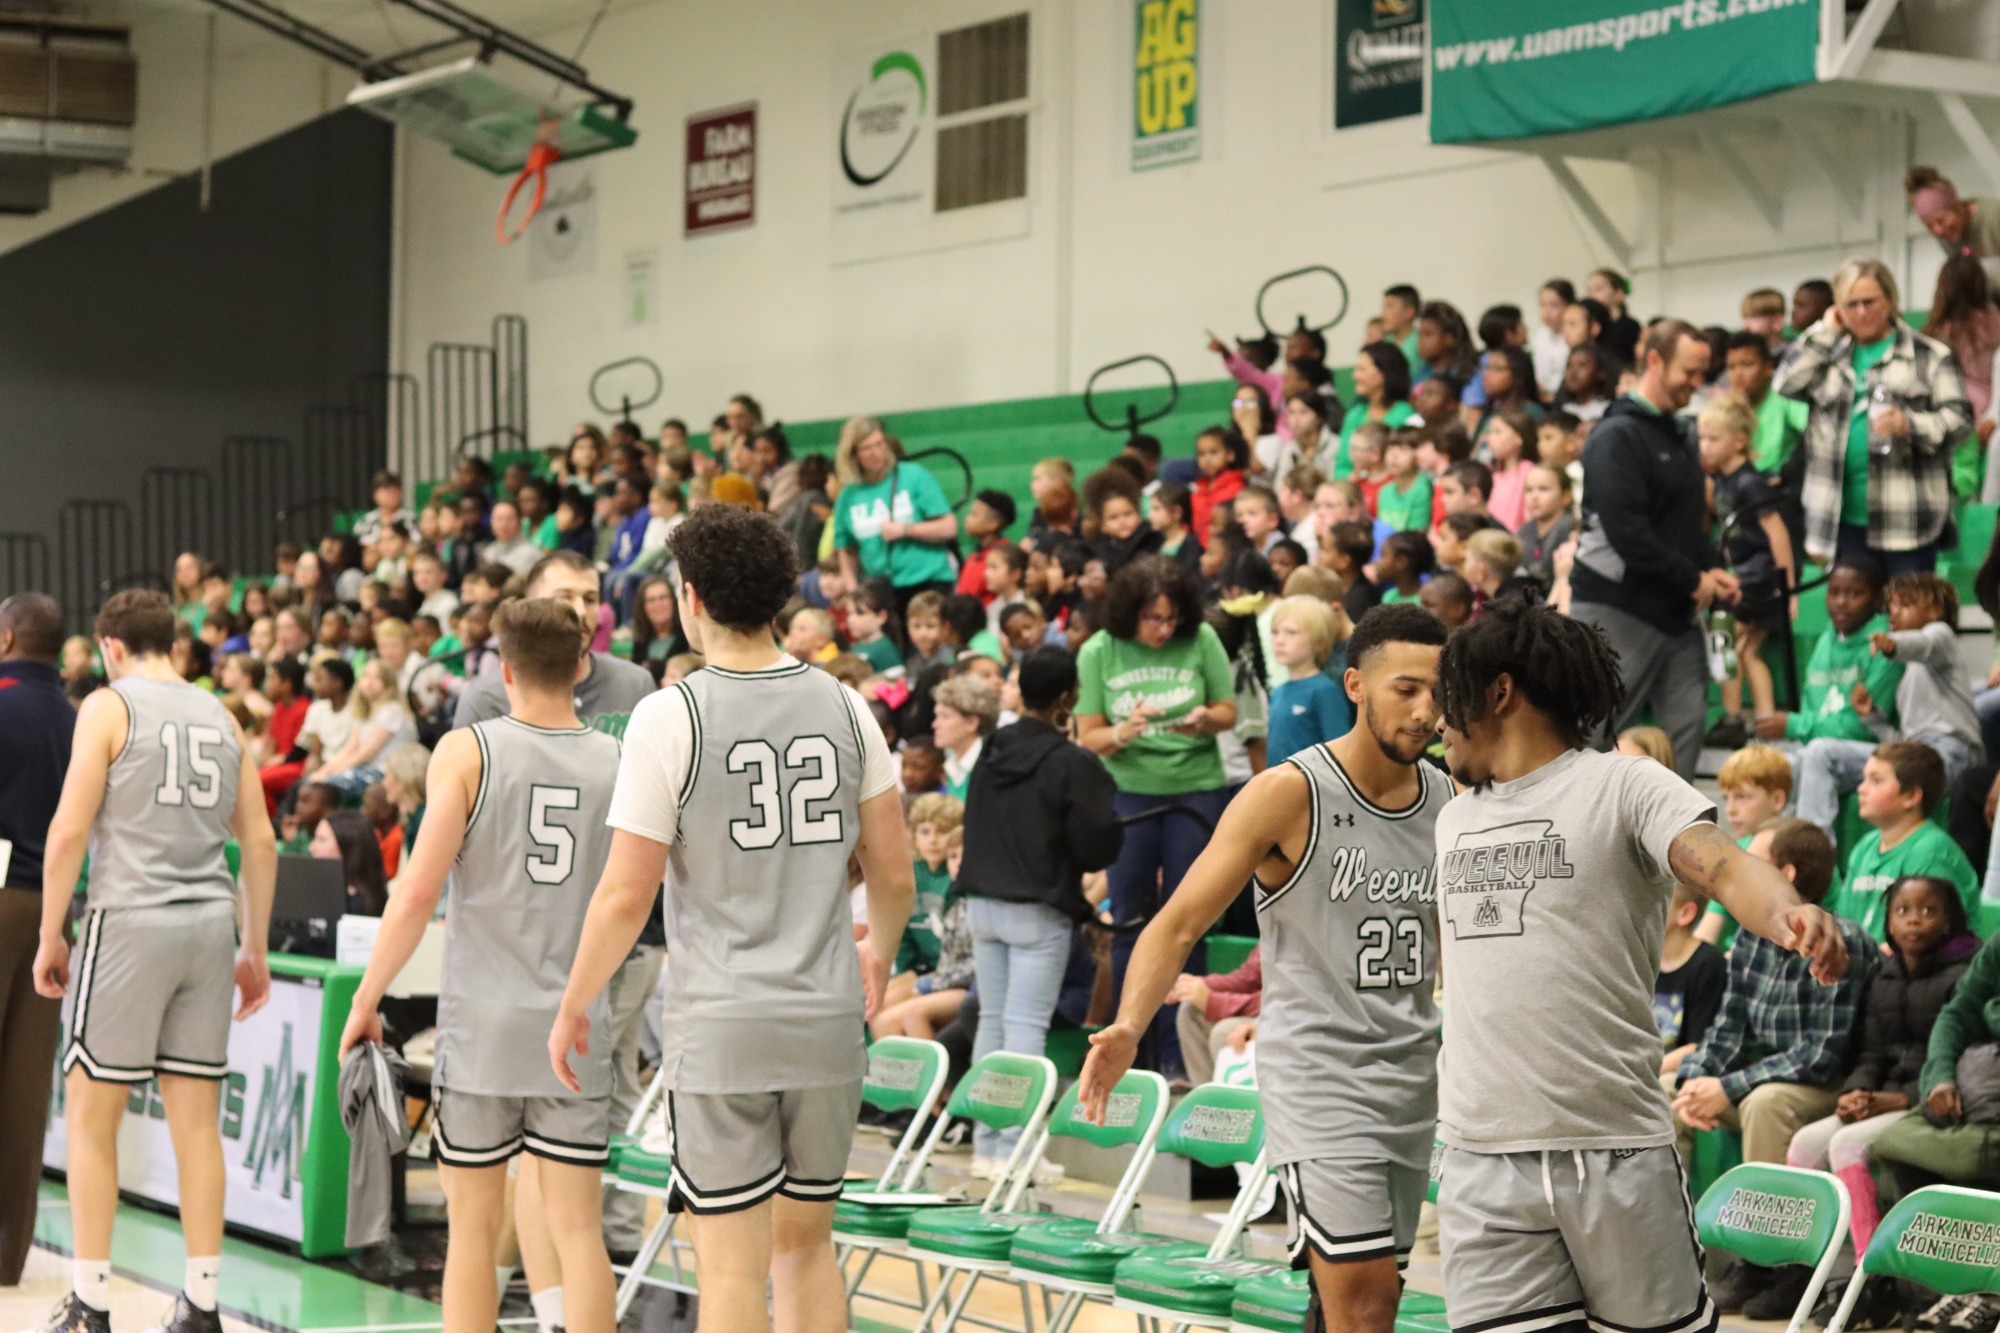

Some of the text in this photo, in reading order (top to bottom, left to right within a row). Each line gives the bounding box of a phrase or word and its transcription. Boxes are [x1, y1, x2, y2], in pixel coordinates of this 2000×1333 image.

[1137, 0, 1195, 68] AG
[1435, 0, 1807, 71] www.uamsports.co
[1139, 60, 1196, 134] UP
[155, 721, 222, 808] 15
[726, 734, 842, 850] 32
[525, 783, 579, 885] 5
[1441, 838, 1574, 888] WEEVIL
[1447, 880, 1529, 895] BASKETBALL
[1355, 916, 1423, 990] 23
[1718, 1206, 1813, 1239] MONTICELLO
[1729, 1187, 1816, 1218] ARKANSAS
[1909, 1211, 2000, 1244] ARKANSAS
[1899, 1230, 2000, 1267] MONTICELLO
